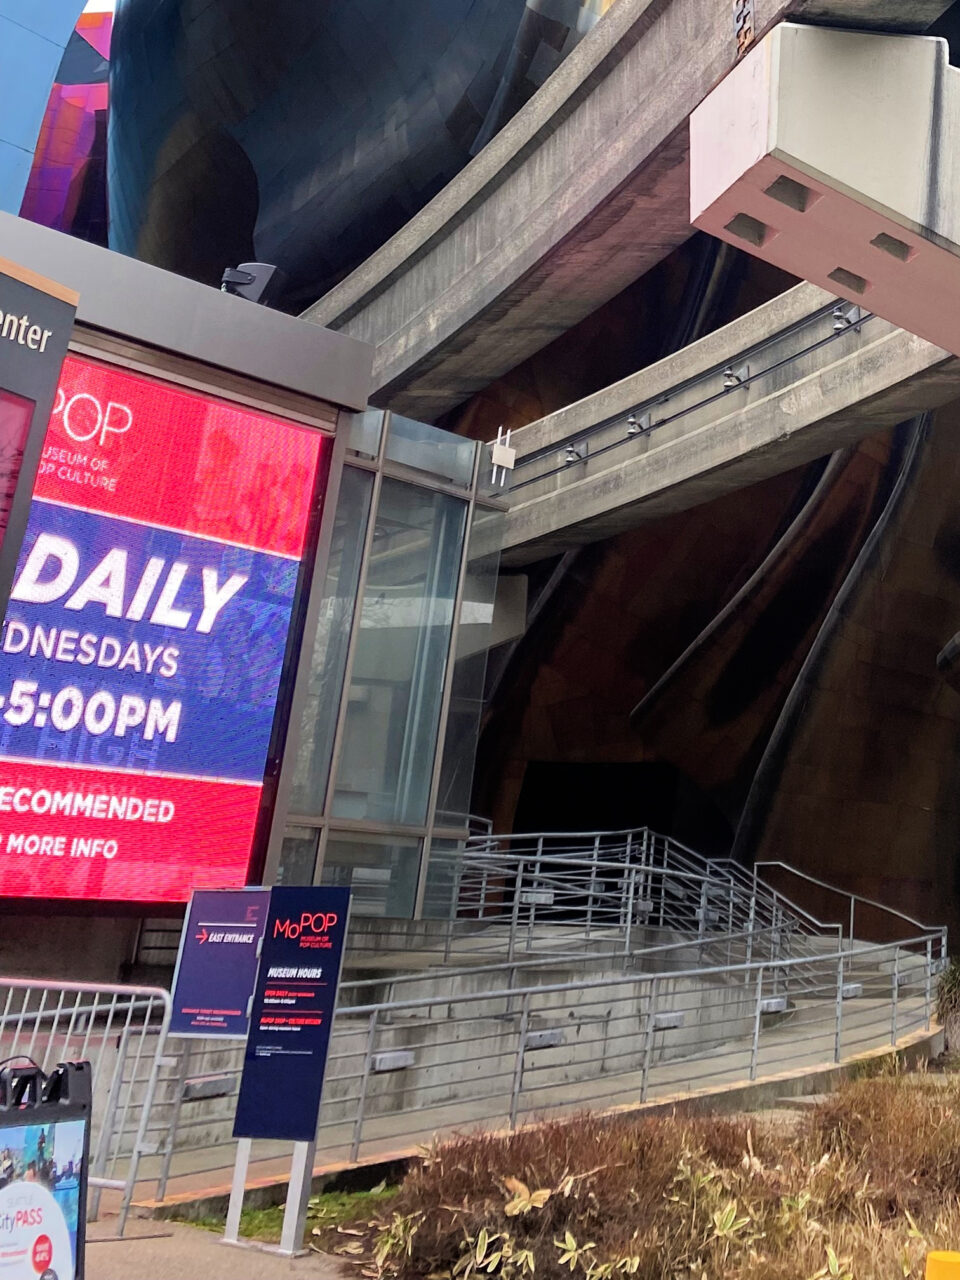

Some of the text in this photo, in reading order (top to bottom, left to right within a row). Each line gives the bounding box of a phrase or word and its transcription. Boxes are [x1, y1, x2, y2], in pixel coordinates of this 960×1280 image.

[90, 457, 110, 471] OF
[58, 466, 118, 492] CULTURE
[10, 532, 248, 634] DAILY
[2, 621, 180, 677] DNESDAYS
[6, 834, 118, 859] MORE INFO
[208, 932, 254, 944] EAST ENTRANCE
[273, 913, 338, 939] MoPOP
[267, 967, 323, 978] MUSEUM HOURS
[0, 1207, 43, 1234] ityPASS
